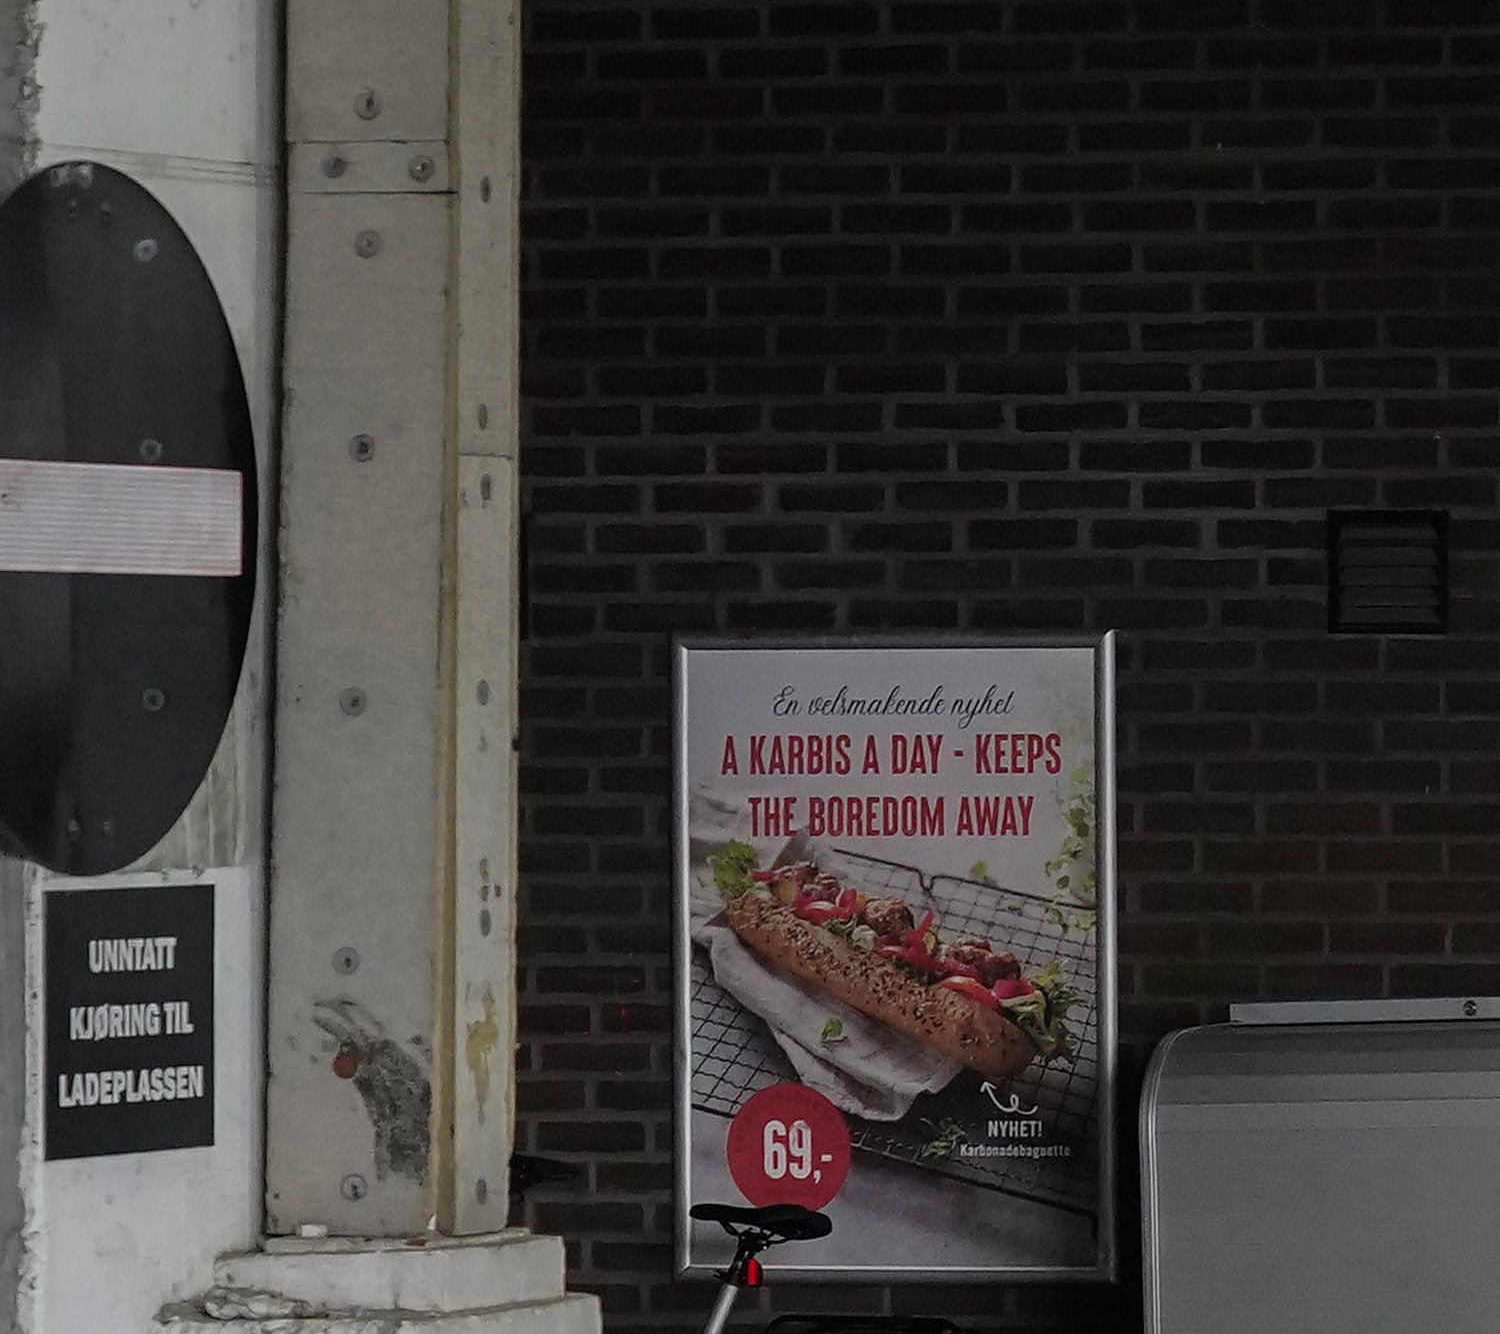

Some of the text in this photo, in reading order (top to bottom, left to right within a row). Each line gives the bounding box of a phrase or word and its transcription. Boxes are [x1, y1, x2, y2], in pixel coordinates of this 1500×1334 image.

[772, 684, 1015, 729] En velsmakende nyhet
[721, 735, 739, 776] A
[750, 734, 852, 776] KARBIS
[862, 734, 881, 775] A
[891, 734, 945, 775] DAY
[975, 733, 1063, 775] KEEPS
[749, 796, 1034, 838] THE BOREDOM AWAY
[89, 937, 178, 973] UNNTATT
[69, 1001, 195, 1041] KJØRING TIL
[58, 1065, 204, 1108] LADEPLASSEN
[987, 1120, 1043, 1138] NYHET!
[763, 1119, 833, 1185] 69,-
[960, 1144, 1072, 1159] Karbonadebaguette
